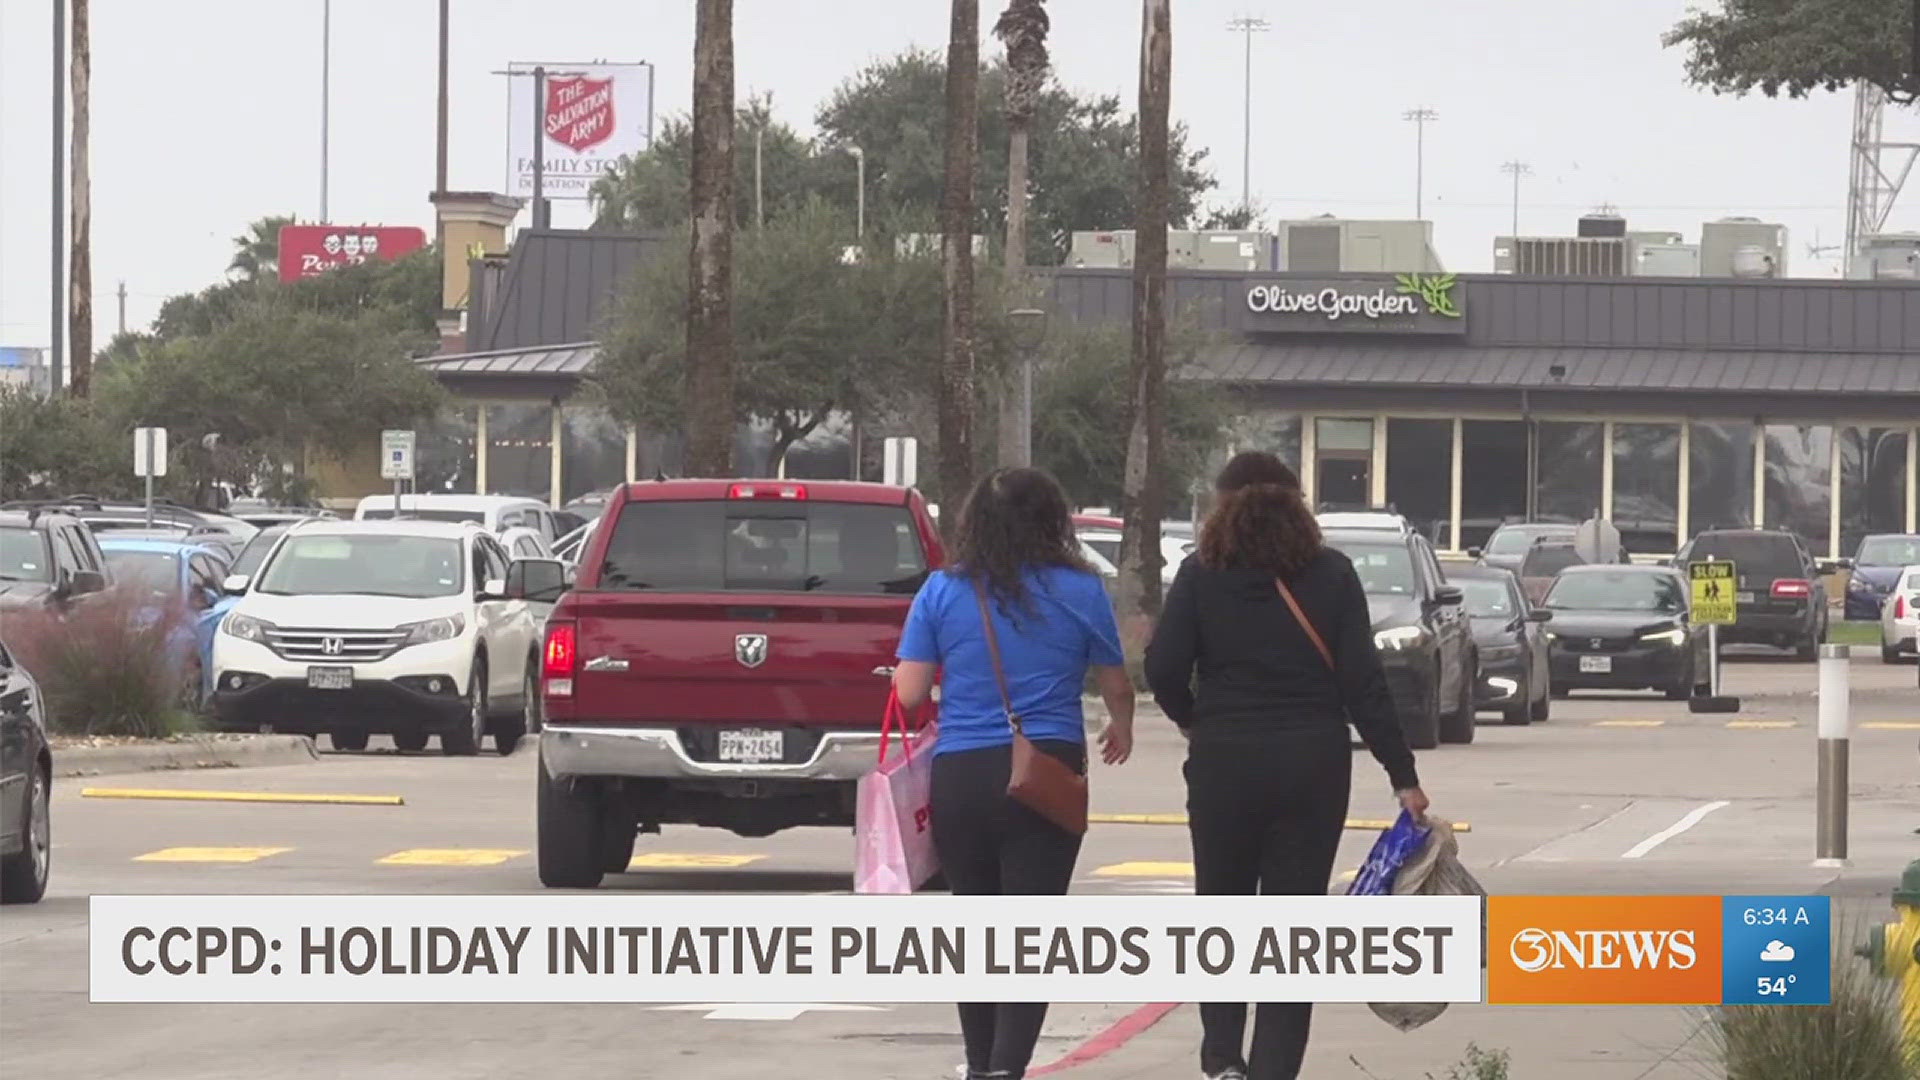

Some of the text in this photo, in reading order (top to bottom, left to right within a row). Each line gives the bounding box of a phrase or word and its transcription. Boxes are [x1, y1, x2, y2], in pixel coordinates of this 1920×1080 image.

[546, 84, 610, 134] SALVATION
[556, 80, 585, 106] THE
[569, 107, 608, 145] ARMY
[1693, 564, 1729, 577] SLOW
